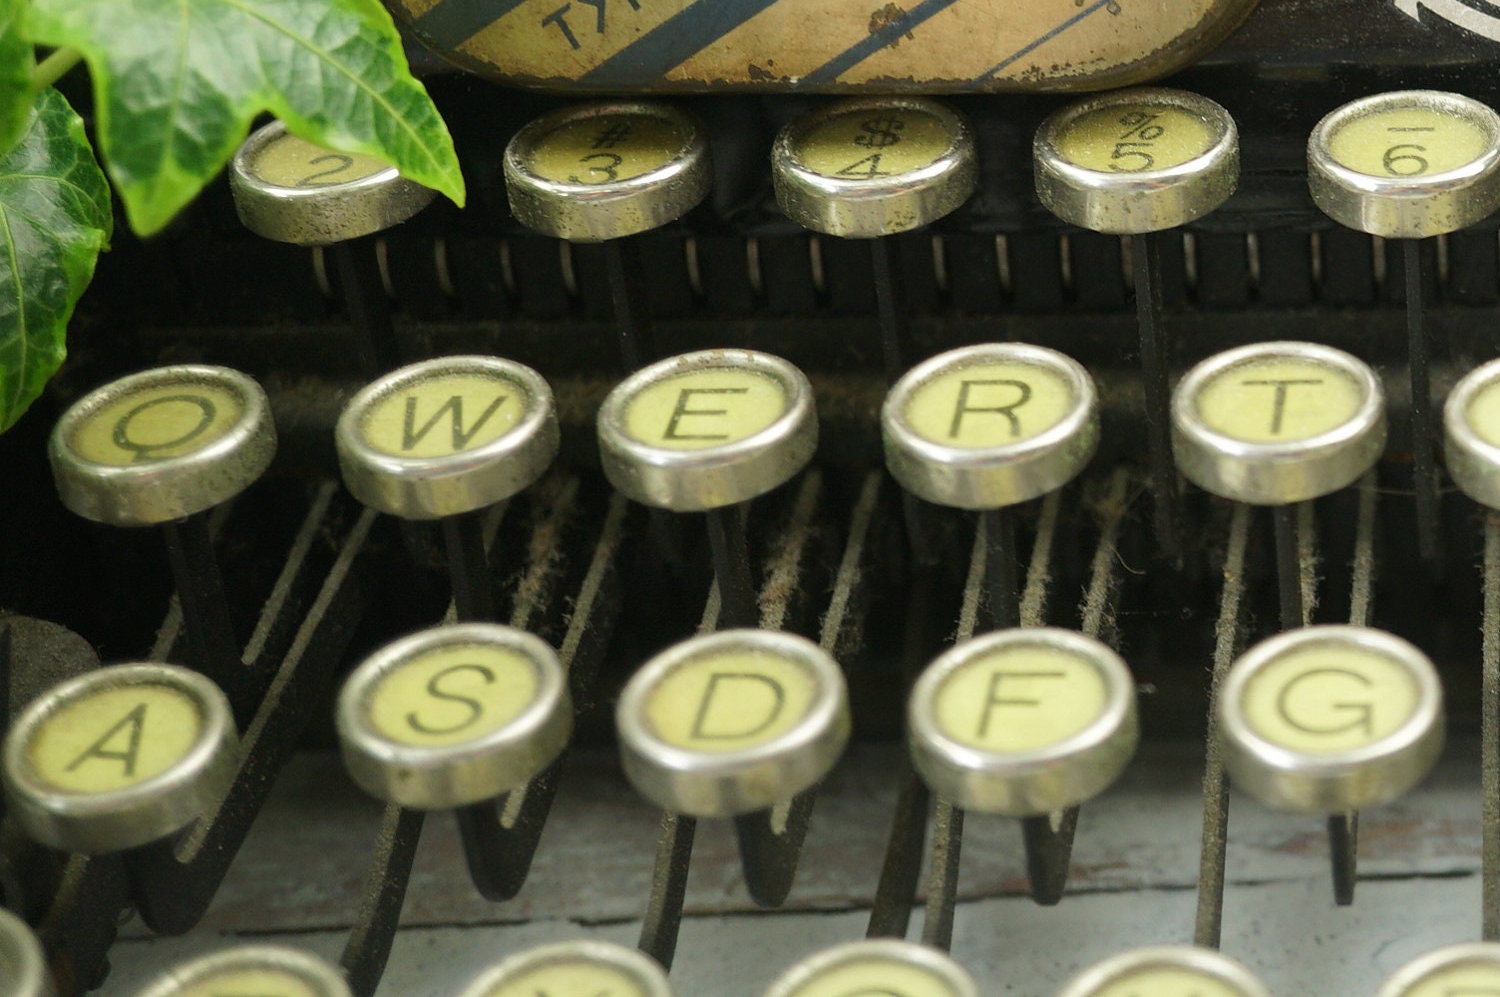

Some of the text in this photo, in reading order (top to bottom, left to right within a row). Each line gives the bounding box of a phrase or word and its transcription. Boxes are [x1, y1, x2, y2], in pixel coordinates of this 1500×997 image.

[295, 154, 354, 187] 2
[568, 152, 623, 185] 3
[835, 153, 892, 180] 4
[1108, 141, 1154, 173] 5
[1382, 143, 1429, 177] 6
[400, 395, 511, 452] W
[662, 387, 748, 442] E
[945, 378, 1033, 439] R
[1240, 378, 1324, 435] T
[404, 663, 497, 734] S
[689, 672, 785, 741] D
[975, 670, 1068, 740] F
[1276, 668, 1374, 736] G
[64, 702, 149, 776] A
